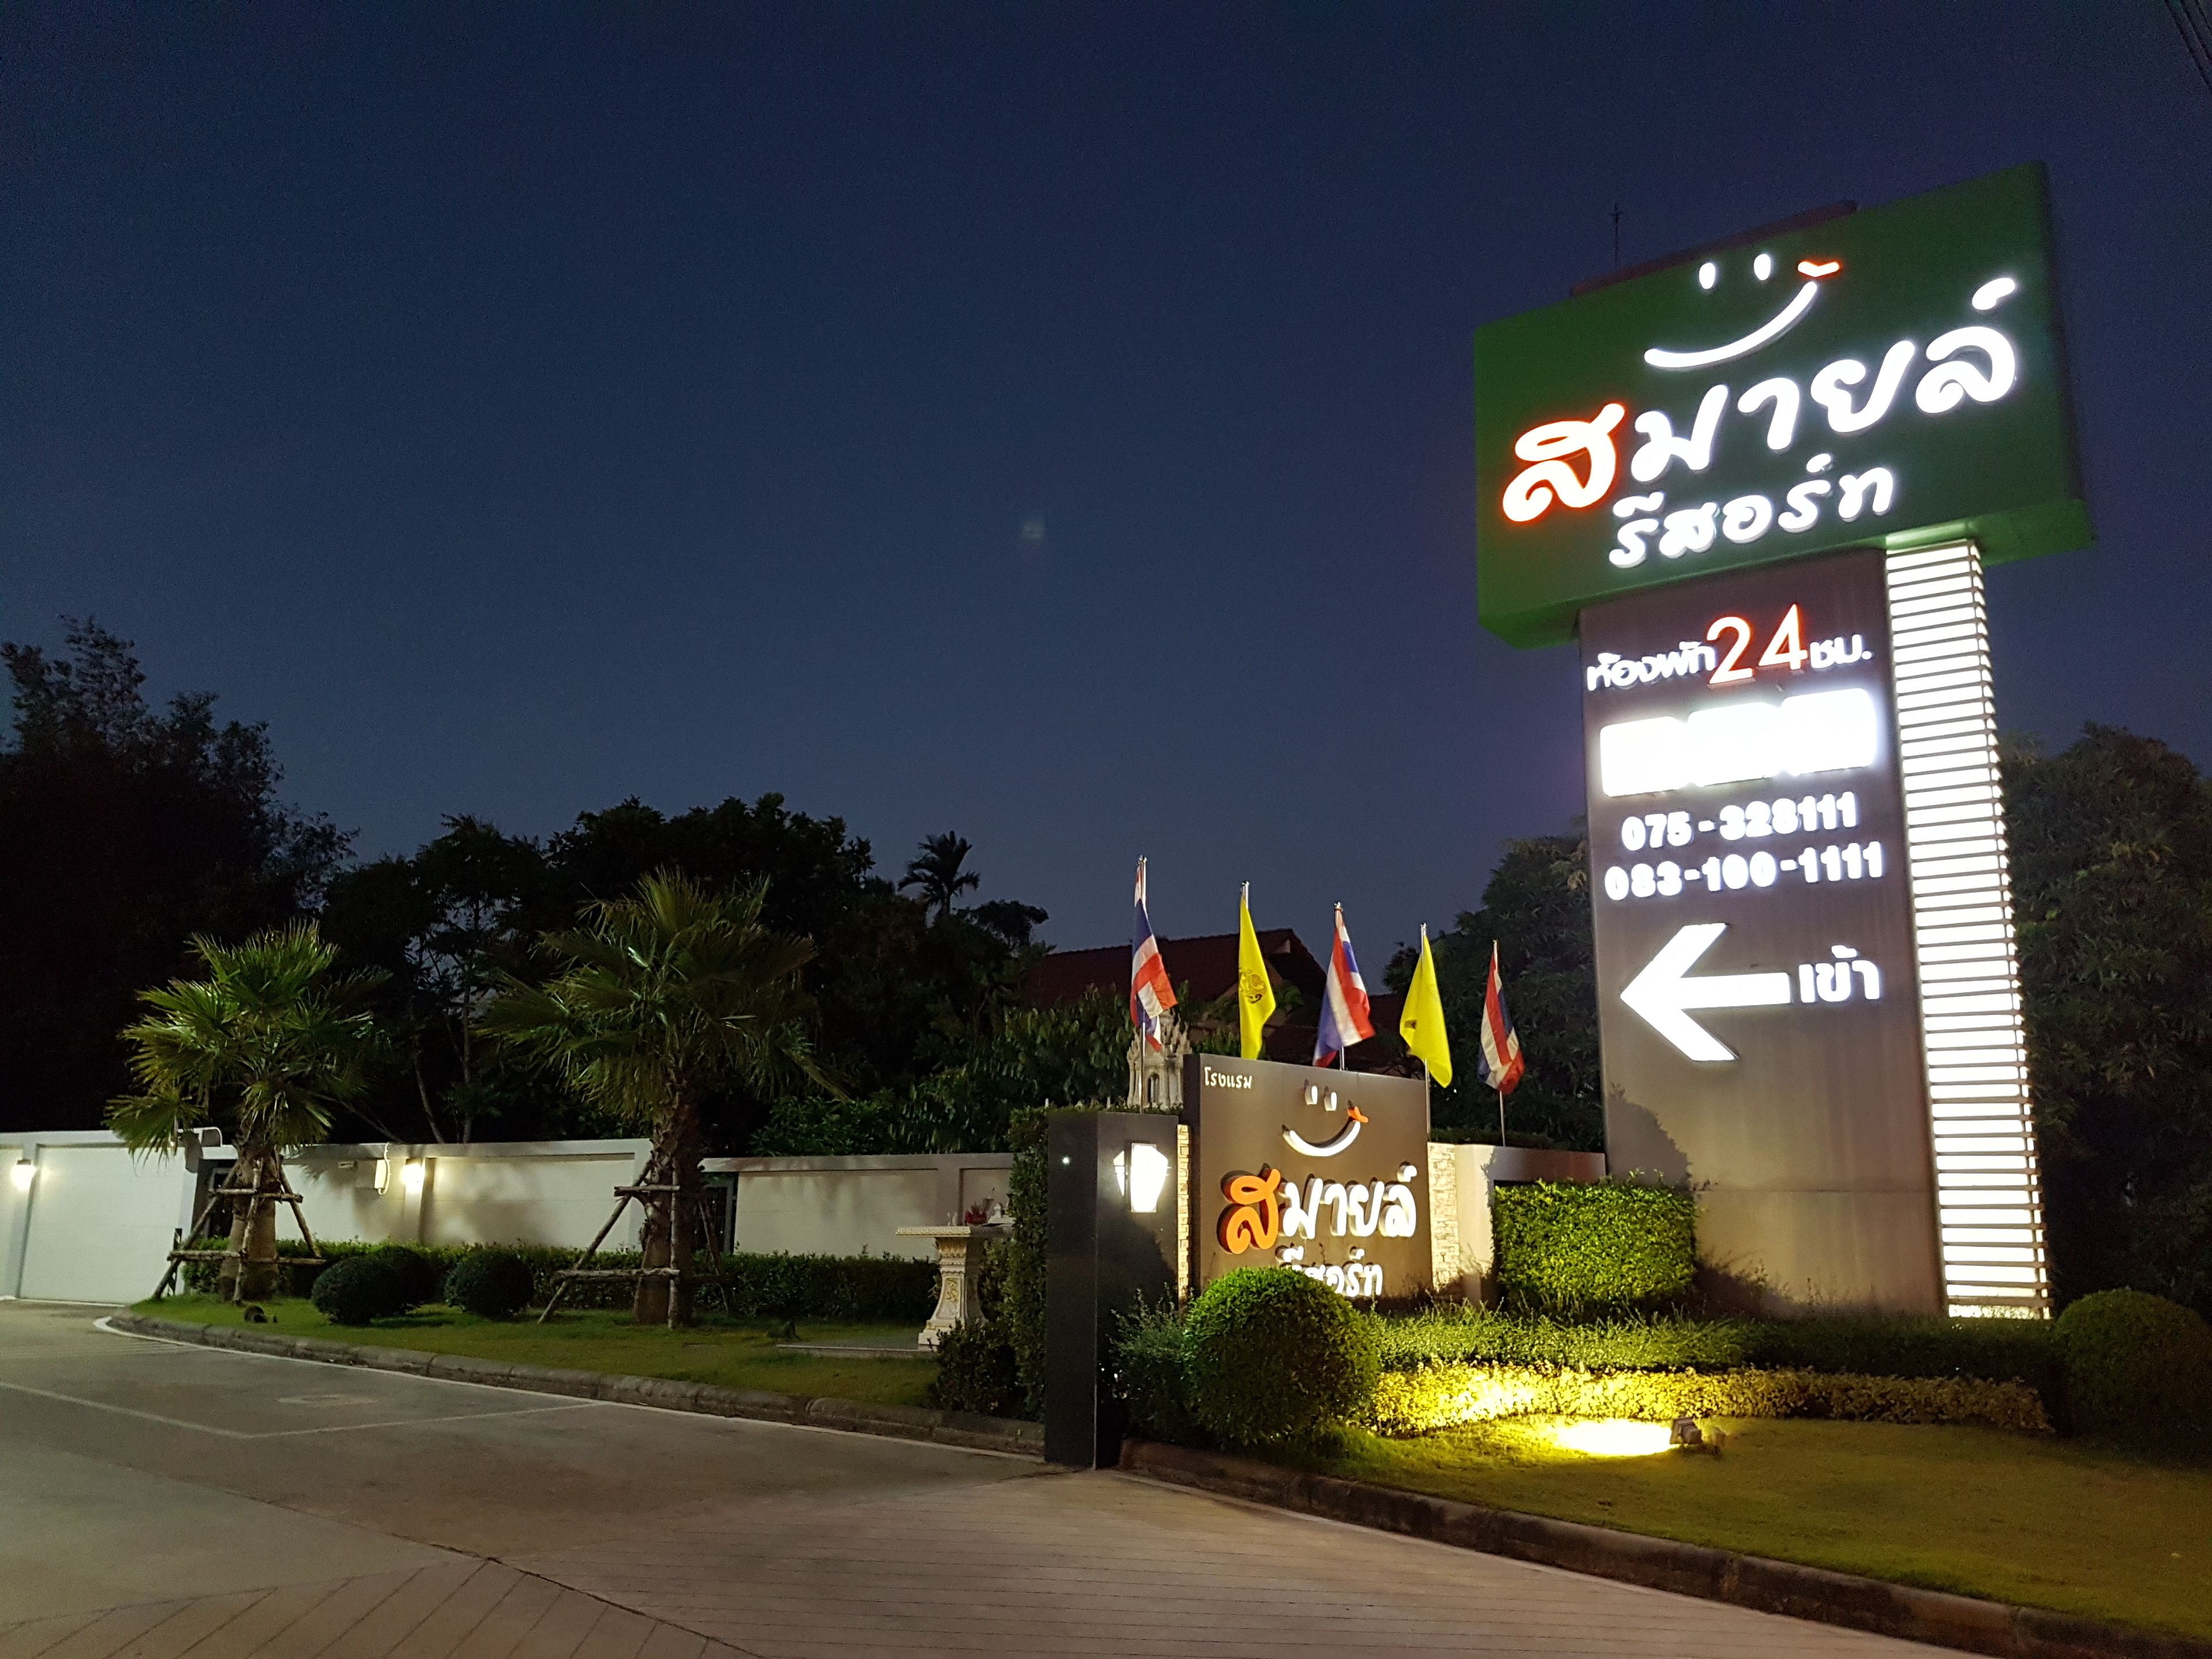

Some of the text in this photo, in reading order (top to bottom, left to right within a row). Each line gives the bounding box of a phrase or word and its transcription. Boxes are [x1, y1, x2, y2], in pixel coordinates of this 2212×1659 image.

[1503, 277, 2017, 522] สมายล์
[1609, 454, 1893, 568] รีสอร์ท
[1707, 603, 1809, 685] 24
[1604, 842, 1883, 900] 083-100-1111
[1798, 945, 1880, 1003] เข้า
[1204, 1067, 1252, 1089] โรงแรม
[1225, 1165, 1417, 1255] สมายล์
